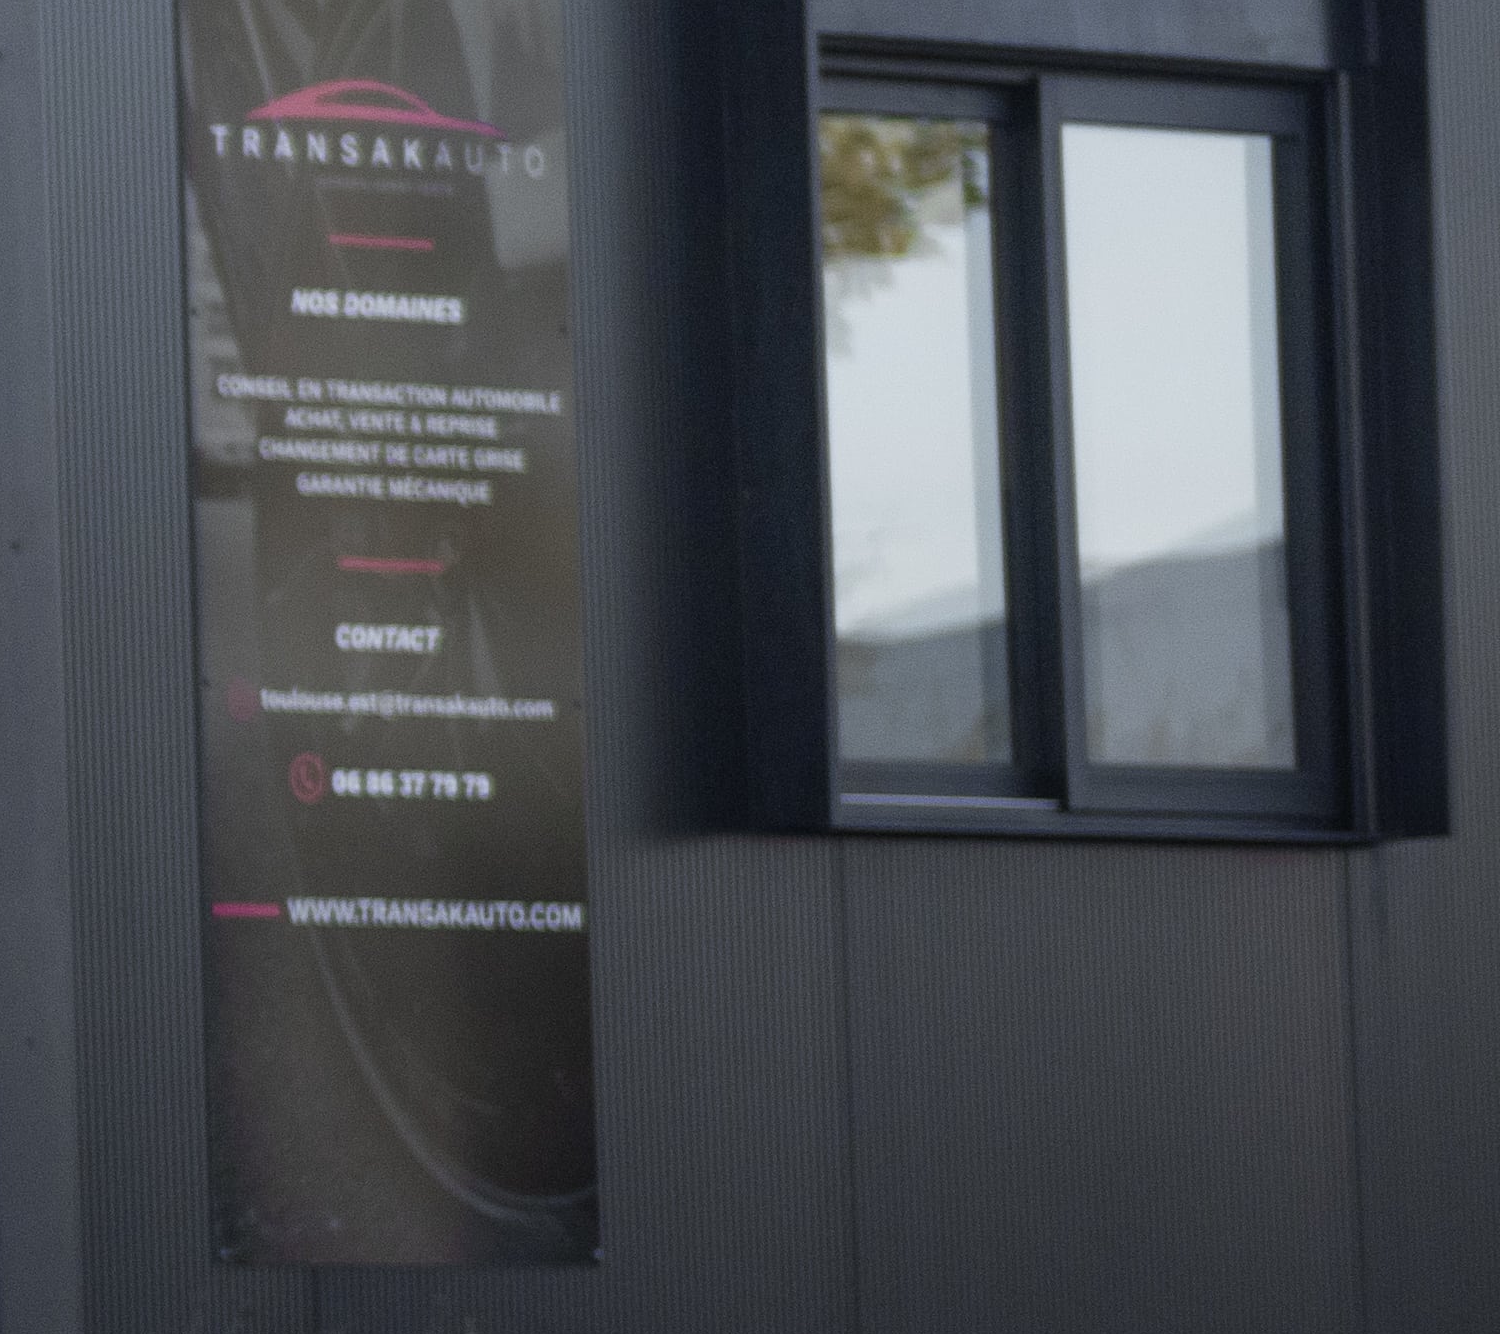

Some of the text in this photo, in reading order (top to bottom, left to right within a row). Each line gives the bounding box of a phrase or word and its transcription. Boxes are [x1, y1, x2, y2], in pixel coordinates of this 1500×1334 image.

[211, 125, 544, 177] TRANSAKAUTO
[292, 290, 462, 321] NOS DOMAINES
[218, 375, 291, 397] CONSEIL
[326, 379, 446, 405] TRANSACTION
[452, 388, 560, 413] AUTOMOBILE
[259, 438, 379, 460] CHANGEMENT
[335, 624, 440, 650] CONTACT
[287, 898, 582, 928] WWW.TRANSAKAUTO.COM
